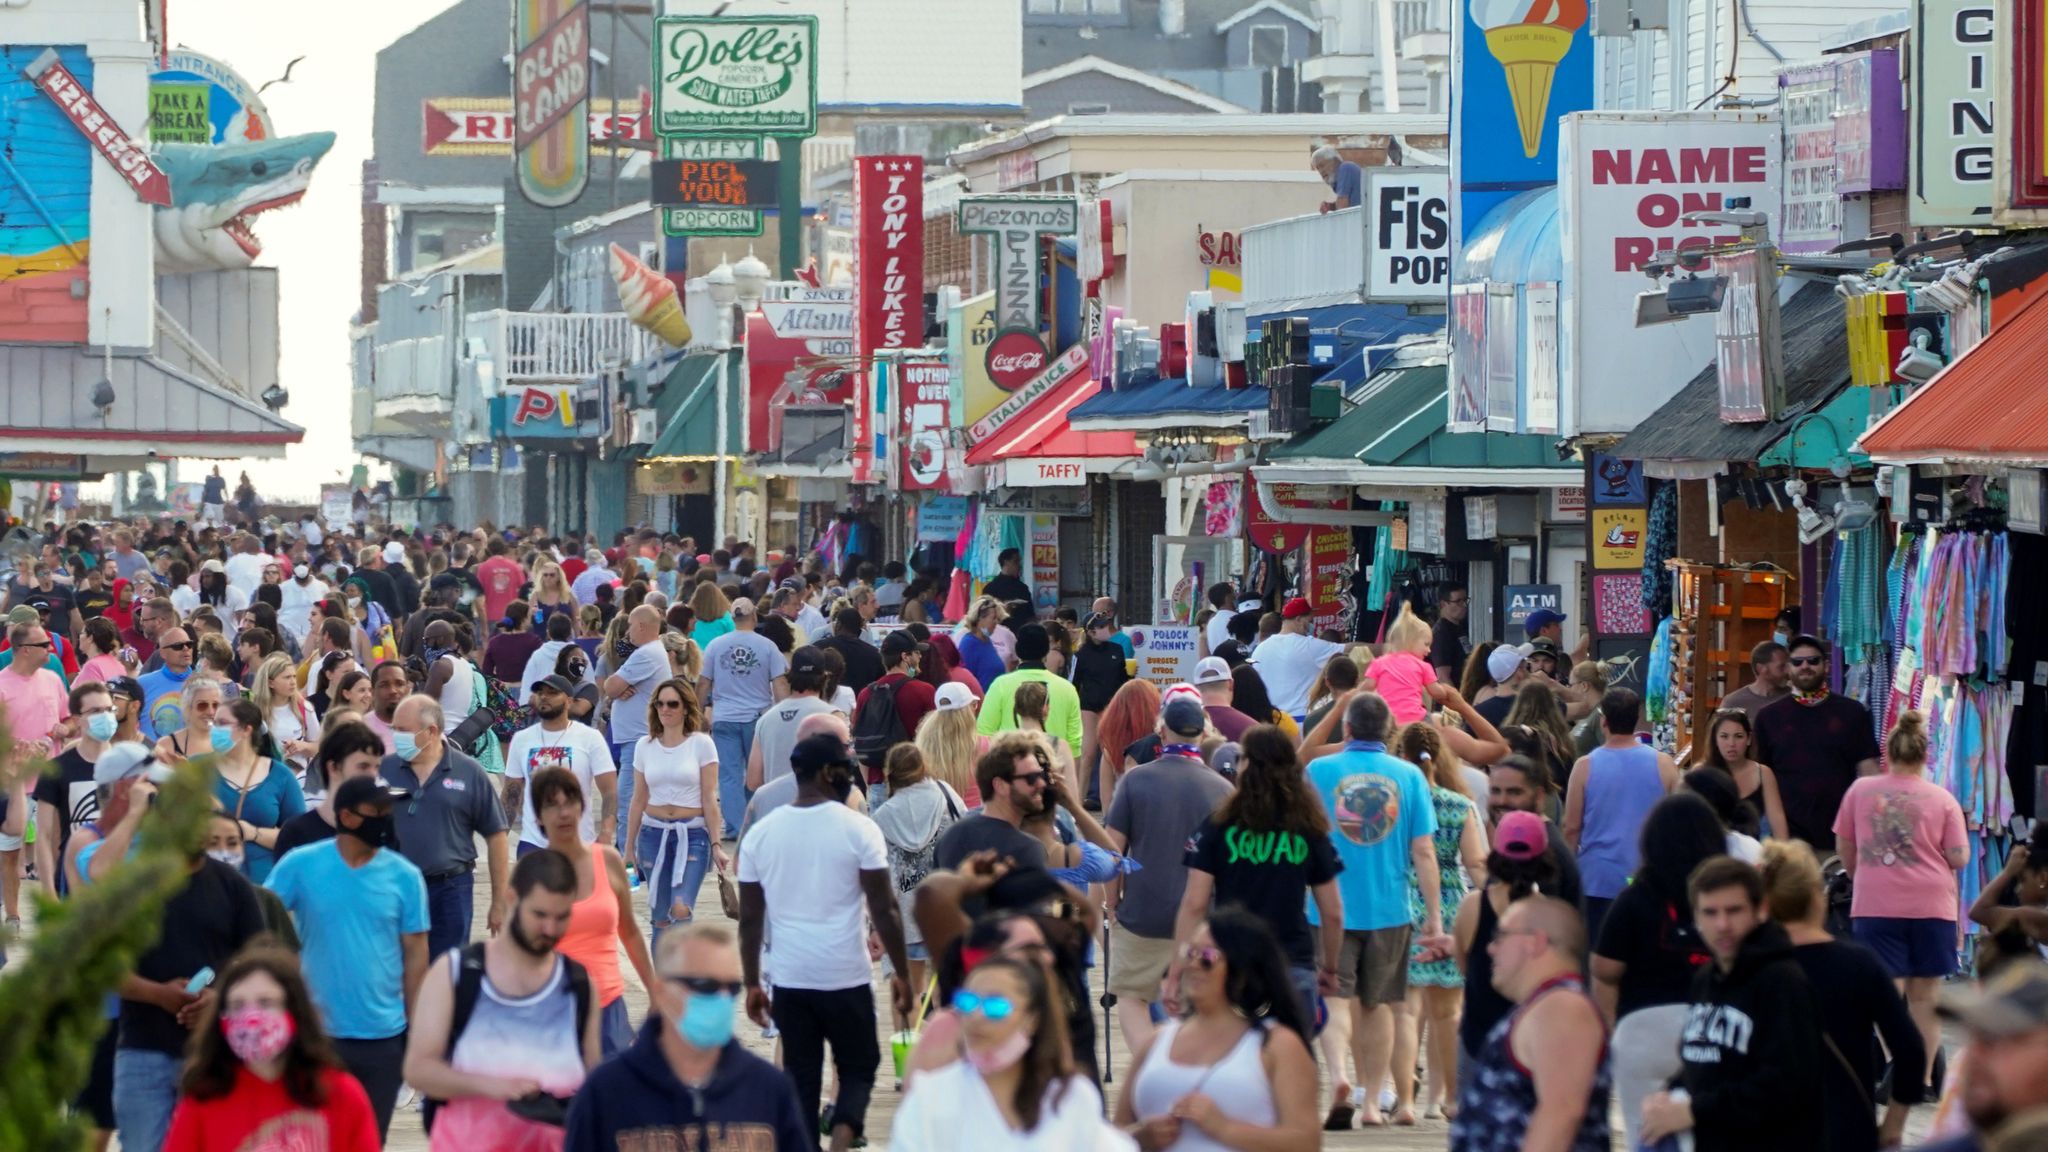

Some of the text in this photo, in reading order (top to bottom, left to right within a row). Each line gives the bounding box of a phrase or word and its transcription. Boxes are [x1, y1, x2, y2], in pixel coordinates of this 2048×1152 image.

[521, 18, 583, 93] PLAY
[666, 27, 803, 82] Dolle's
[153, 94, 205, 110] TAKE A
[521, 62, 585, 133] LAND
[689, 79, 781, 105] SALT WATER TAFFY
[47, 71, 152, 185] ENTRANCE
[154, 112, 205, 129] BREAK
[680, 142, 747, 157] TAFFY
[1592, 146, 1766, 185] NAME
[676, 214, 751, 226] POPCORN
[1637, 192, 1722, 228] ON
[882, 176, 908, 347] TONY LUKES
[1007, 230, 1032, 329] PIZZA
[804, 290, 844, 301] SINCE
[991, 353, 1043, 373] Coca-Cola
[988, 362, 1069, 428] ITALIAN ICE
[1038, 465, 1082, 479] TAFFY
[1511, 594, 1556, 608] ATM
[1225, 826, 1308, 865] SQUAD
